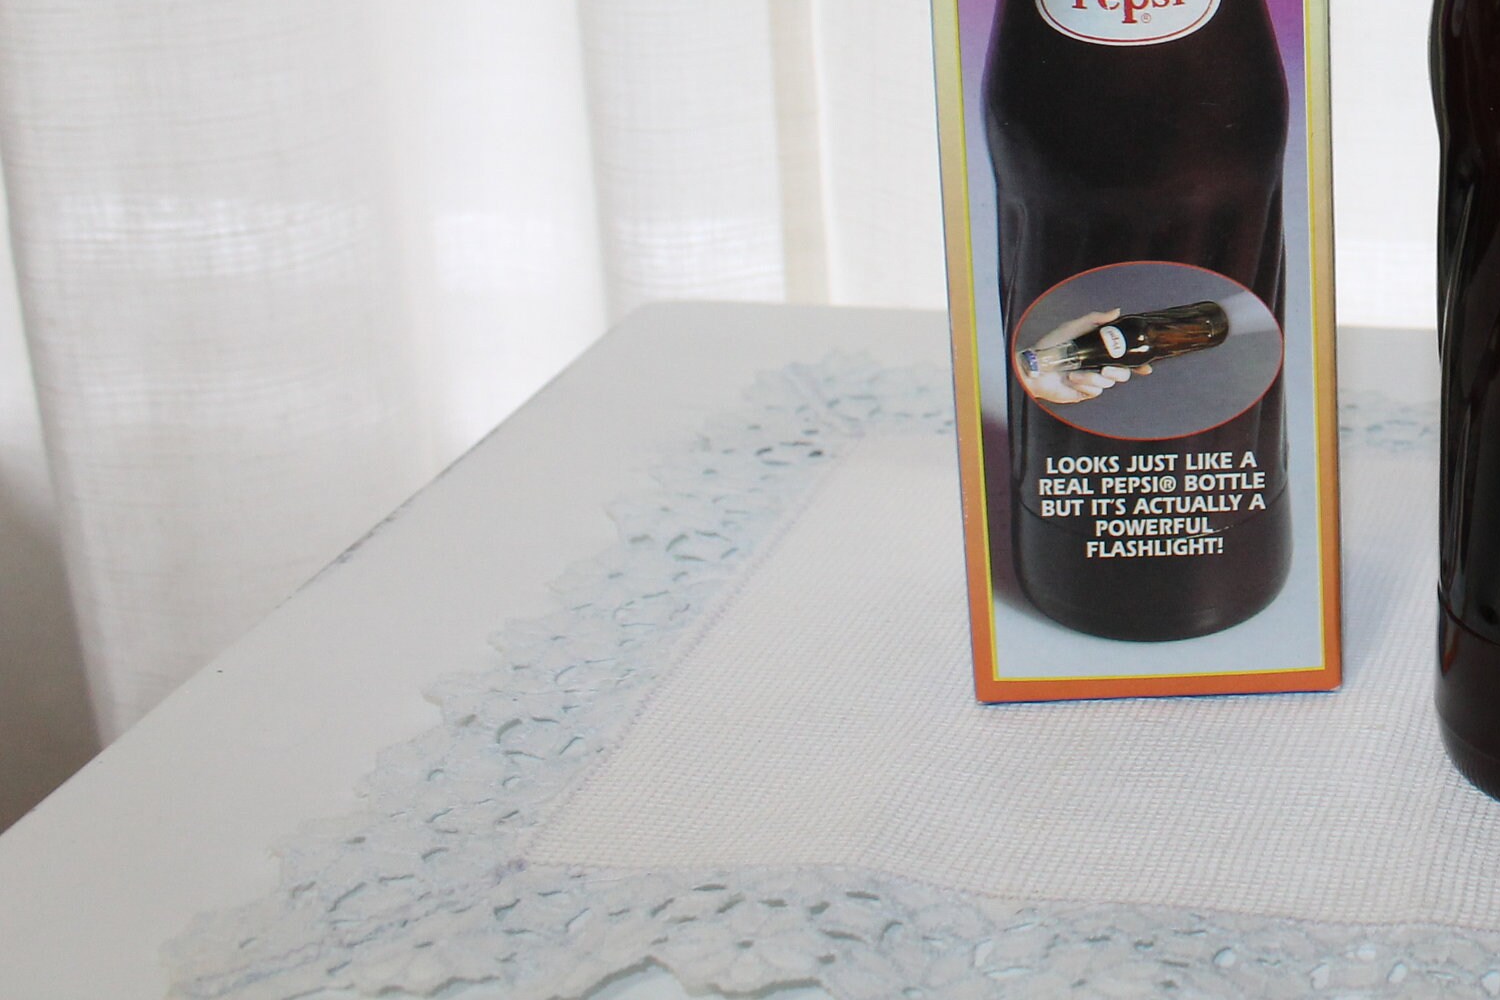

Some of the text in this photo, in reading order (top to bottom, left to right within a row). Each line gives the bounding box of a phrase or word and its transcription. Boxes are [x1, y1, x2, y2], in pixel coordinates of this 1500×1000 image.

[1045, 451, 1258, 475] LOOKS JUST LIKE A
[1038, 478, 1094, 496] REAL
[1184, 472, 1266, 492] BOTTLE
[1041, 493, 1267, 517] BUT IT'S ACTUALLY A
[1095, 517, 1214, 537] POWERFUL
[1086, 537, 1224, 558] FLASHLIGHT!
